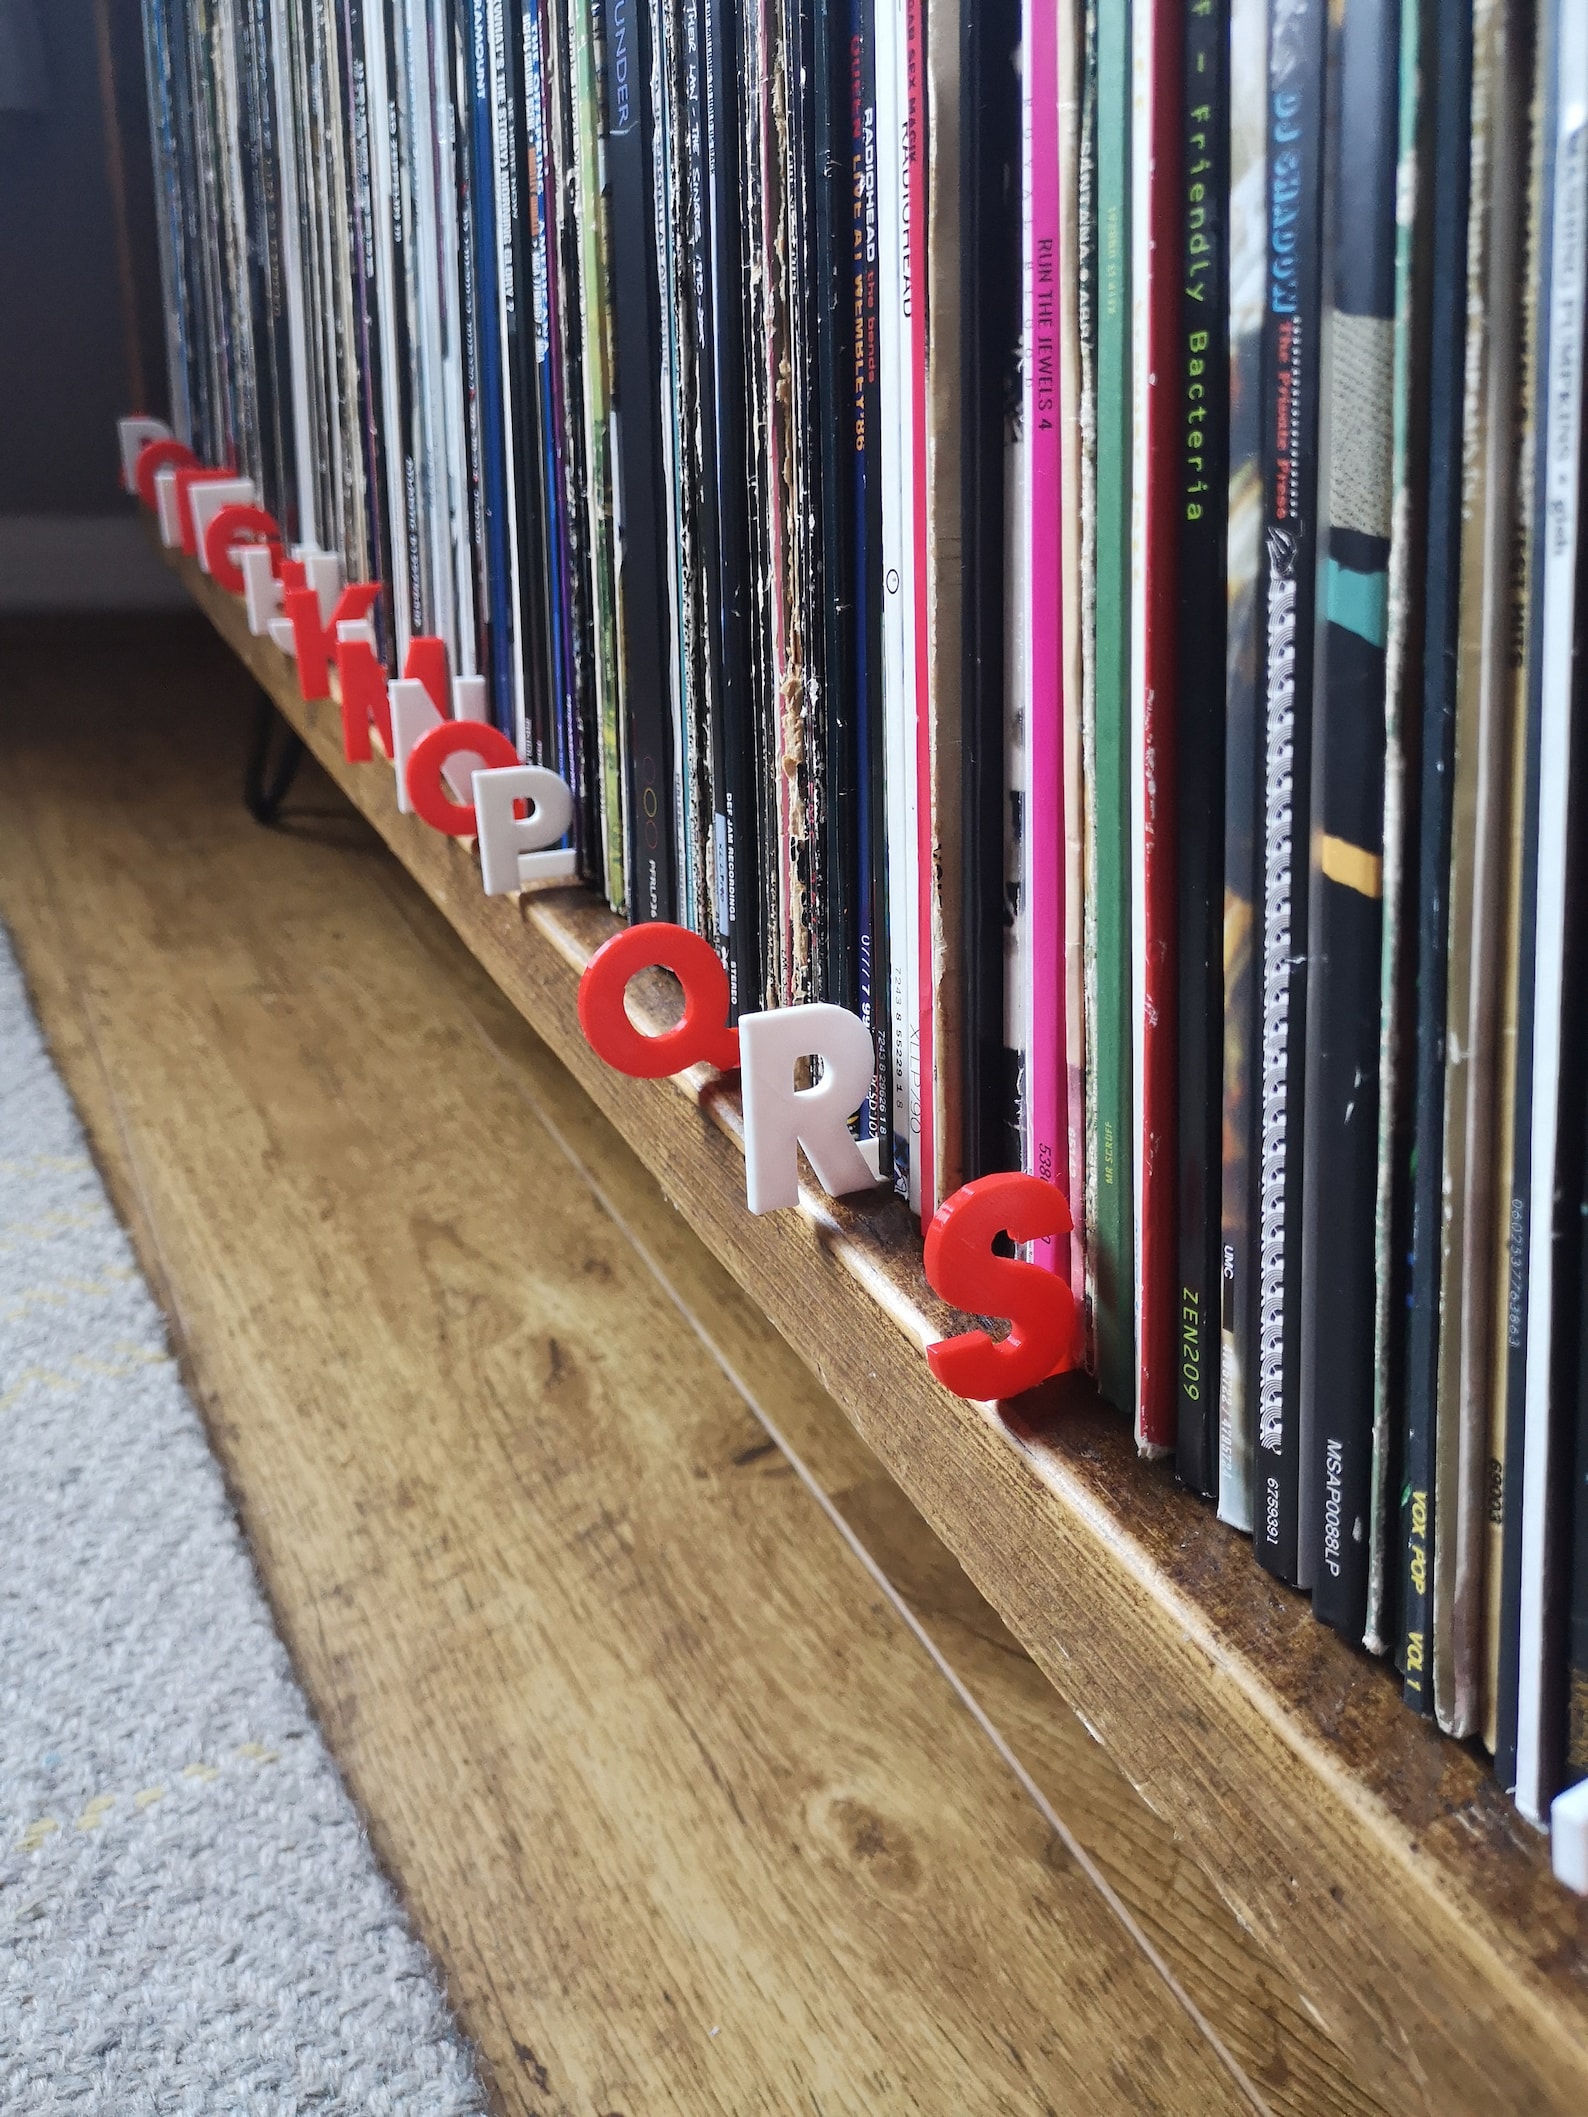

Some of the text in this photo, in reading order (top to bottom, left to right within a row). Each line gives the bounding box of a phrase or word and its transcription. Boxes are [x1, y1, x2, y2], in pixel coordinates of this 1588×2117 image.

[688, 64, 699, 102] LAW
[691, 122, 700, 157] THE
[500, 169, 513, 246] MORNING
[1186, 104, 1212, 302] Friendly
[864, 107, 877, 385] RADIOHEAD the bends
[1037, 238, 1054, 431] RUN THE JEWELS 4
[1187, 331, 1210, 520] Bacteria
[472, 764, 575, 897] P
[649, 858, 658, 919] PFRLP36
[728, 846, 736, 922] RECORDINGS
[577, 922, 743, 1080] Q
[730, 960, 738, 1006] STEREO
[895, 1011, 902, 1022] 8
[878, 1029, 886, 1059] 7243
[879, 1062, 886, 1072] 8
[895, 1028, 903, 1077] 55229
[909, 1023, 921, 1135] XLLP790
[738, 1003, 876, 1216] R
[879, 1074, 887, 1113] 29626
[880, 1125, 887, 1135] 8
[896, 1099, 903, 1109] 8
[1104, 1121, 1114, 1185] MR SCRUFF
[923, 1170, 1084, 1401] S
[1223, 1244, 1234, 1280] UMC
[1182, 1286, 1200, 1400] ZEN209
[1265, 1476, 1279, 1546] 6759391
[1325, 1438, 1343, 1578] MSAP0088LP
[1406, 1489, 1428, 1692] VOX POP VOL 1
